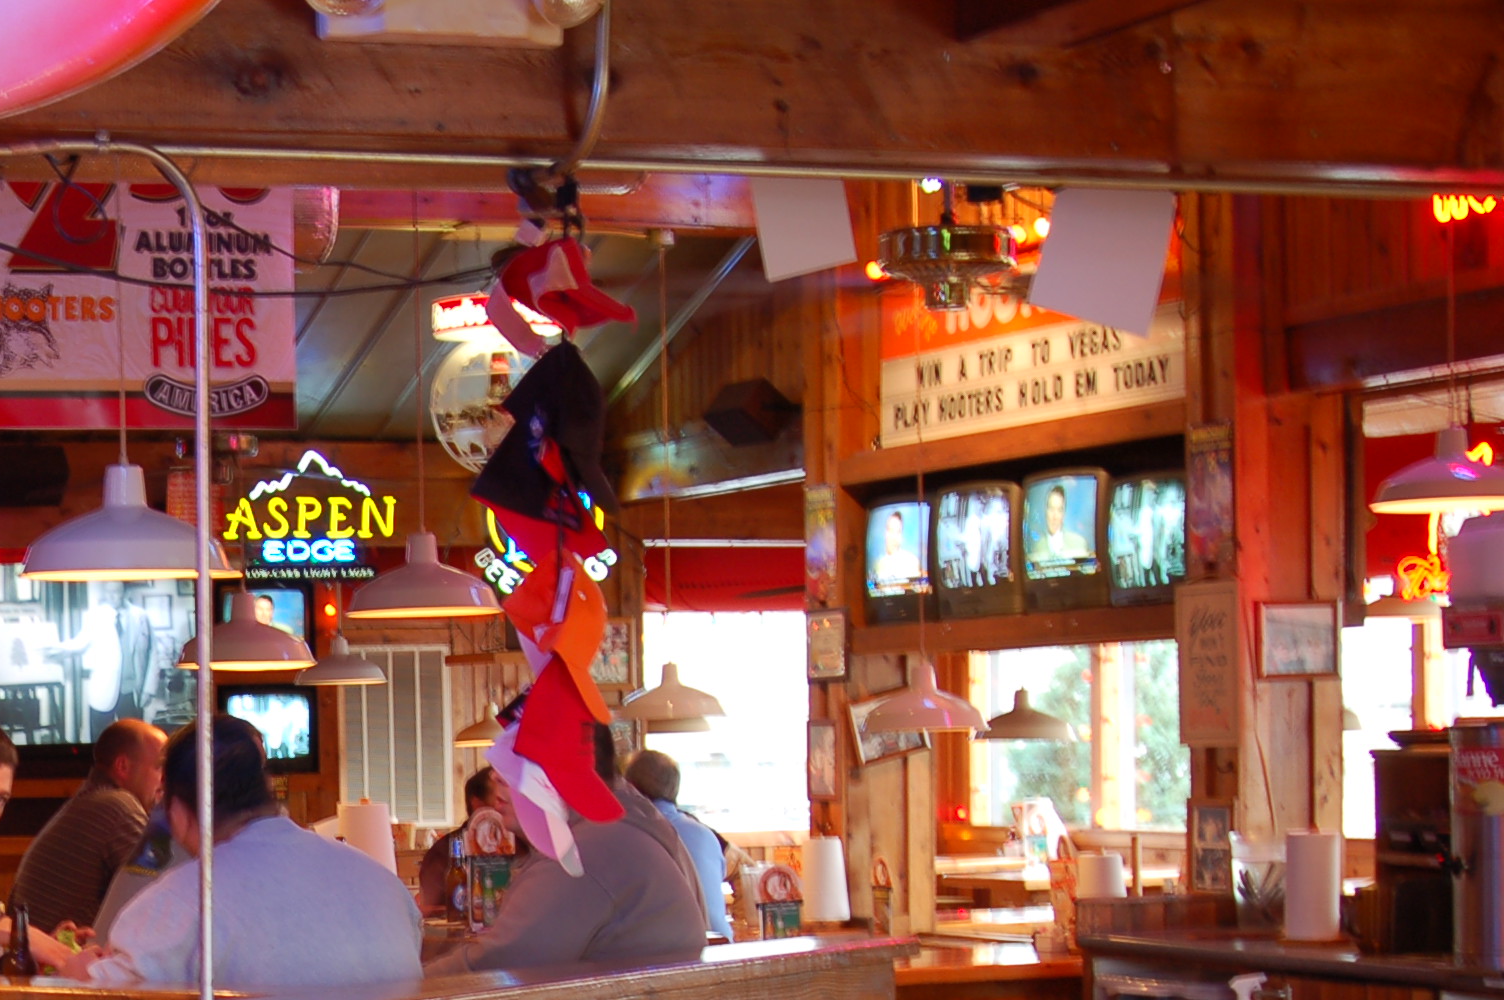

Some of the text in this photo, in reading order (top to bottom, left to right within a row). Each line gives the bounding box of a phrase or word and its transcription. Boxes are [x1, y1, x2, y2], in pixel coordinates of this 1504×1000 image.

[915, 326, 1123, 389] WIN A TRIP TO VEGAS
[893, 355, 1171, 430] PLAY HOOTERS HOLD EM TODAY
[222, 495, 397, 540] ASPEN
[262, 539, 356, 563] EDGE
